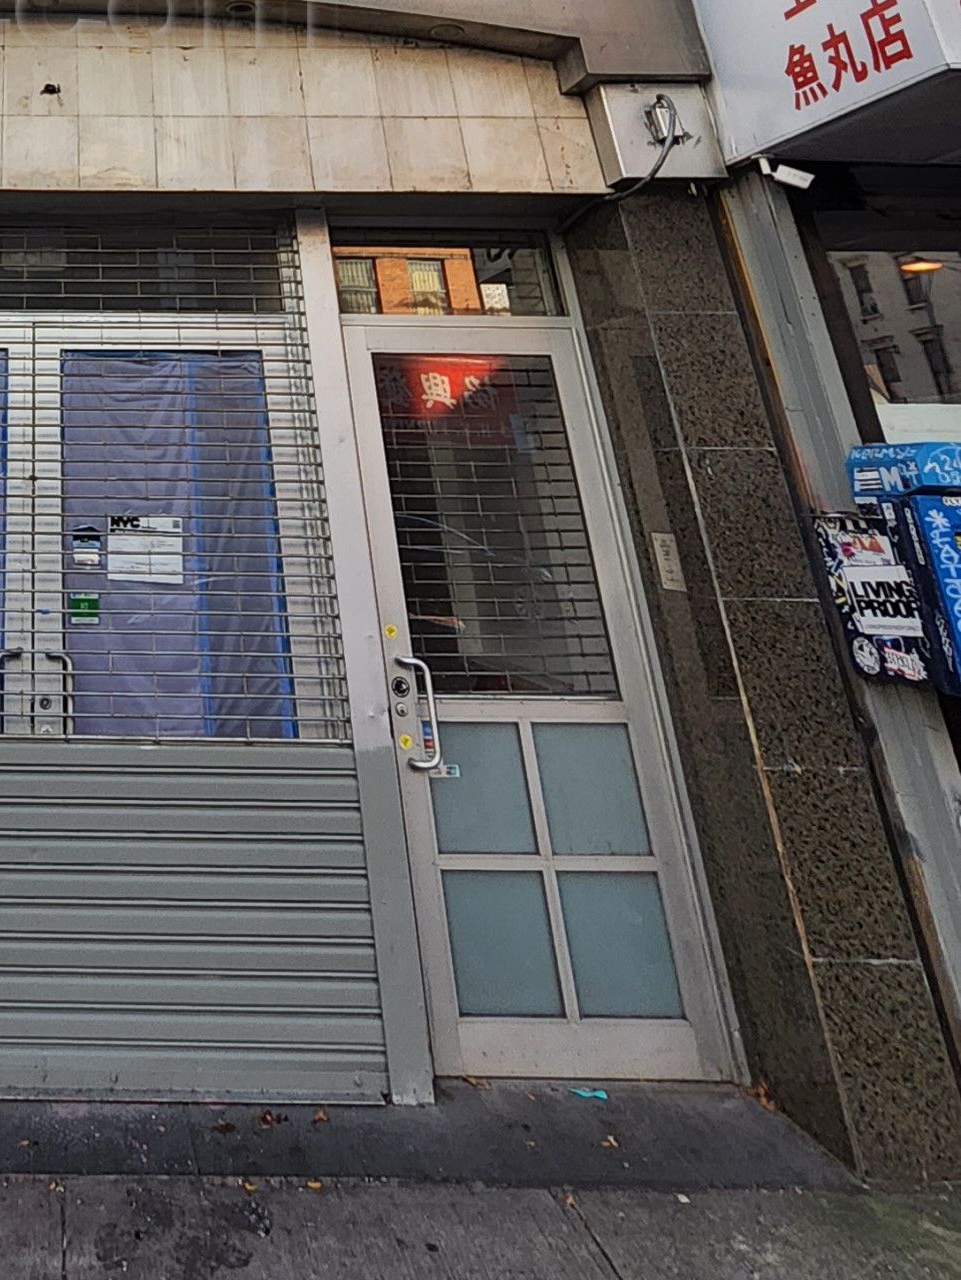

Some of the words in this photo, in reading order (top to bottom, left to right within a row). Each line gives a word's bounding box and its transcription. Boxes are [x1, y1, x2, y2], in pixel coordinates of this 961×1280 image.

[110, 516, 141, 529] NYC
[849, 581, 918, 599] LIVING
[856, 600, 919, 618] PROOF
